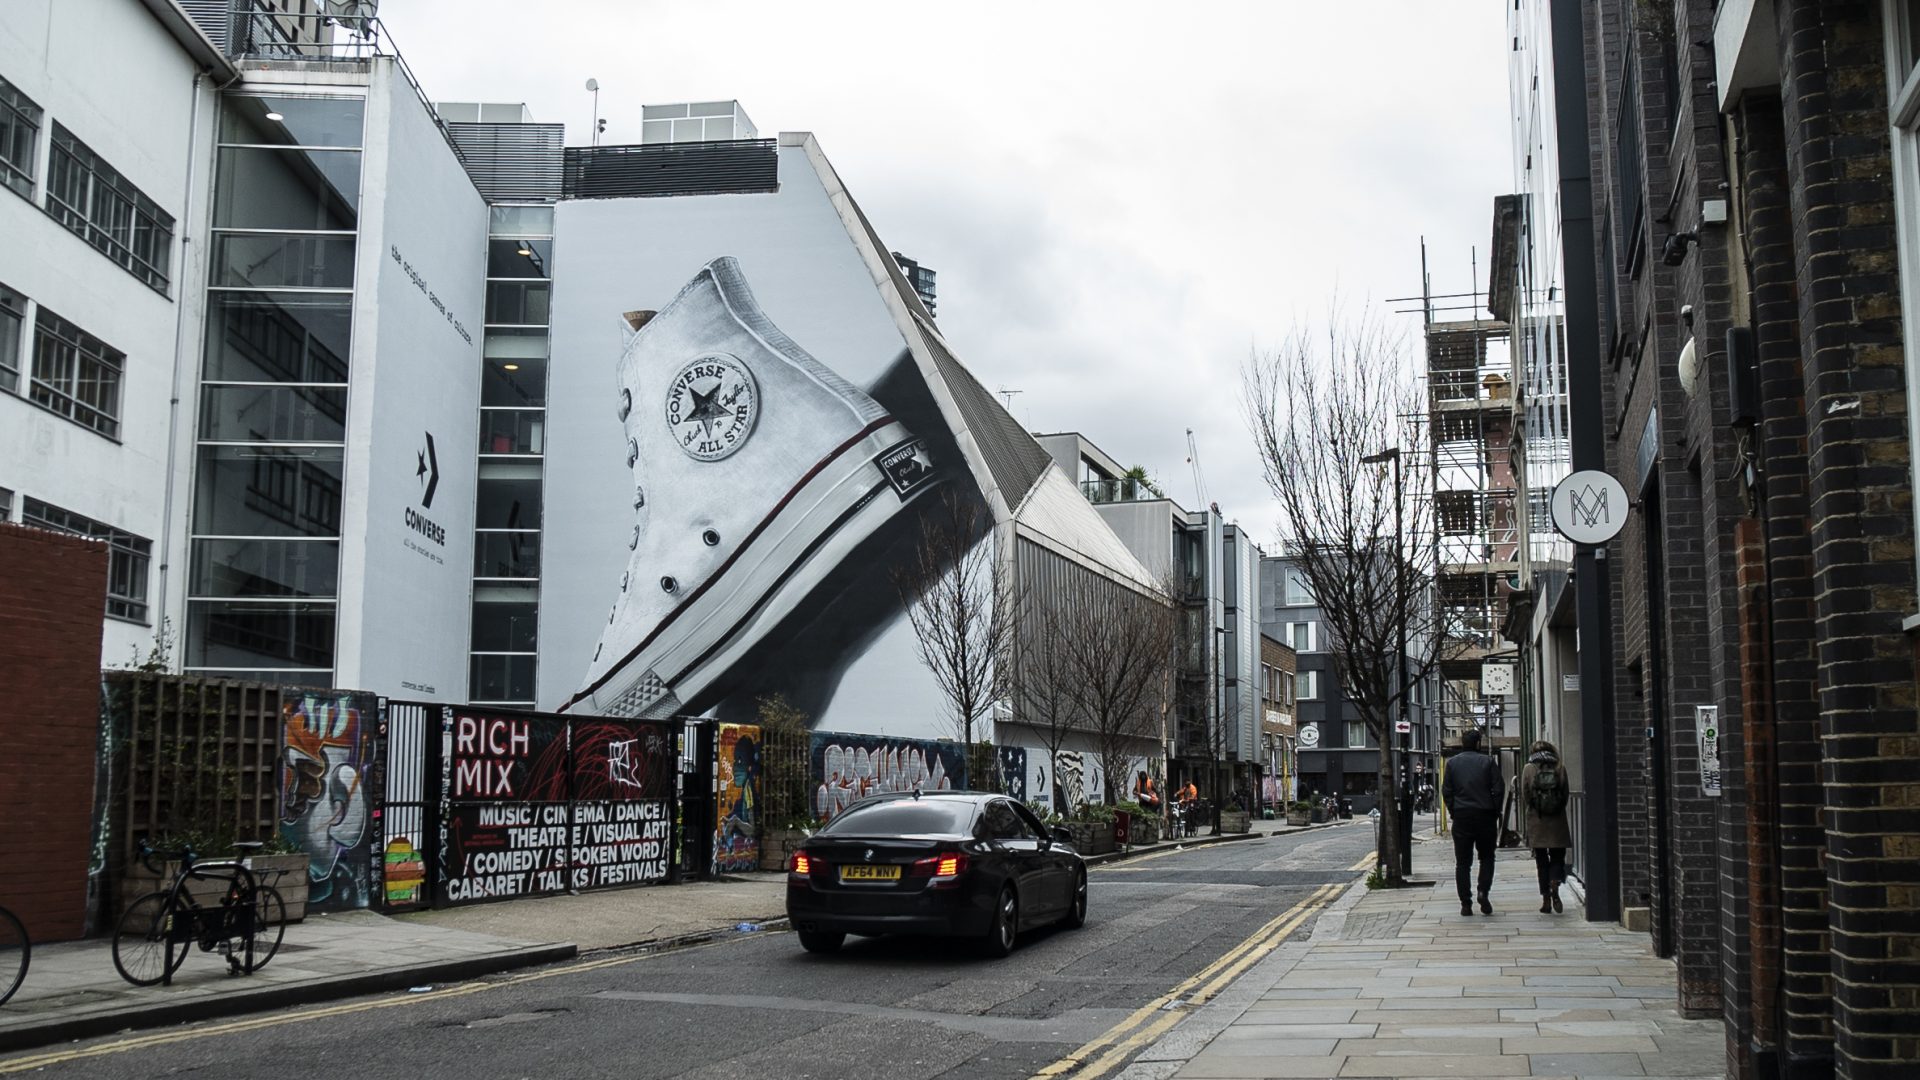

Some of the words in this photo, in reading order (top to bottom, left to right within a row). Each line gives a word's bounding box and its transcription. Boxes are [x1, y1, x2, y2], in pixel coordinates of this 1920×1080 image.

[670, 365, 726, 426] CONVERSE
[698, 440, 724, 453] ALL
[724, 404, 748, 444] STAR
[405, 506, 446, 547] CONVERSE
[457, 717, 529, 756] RICH
[456, 759, 514, 796] MIX
[480, 806, 531, 826] MUSIC
[543, 804, 605, 825] CINEMA
[616, 803, 660, 821] DANCE
[508, 826, 581, 849] THEATRE
[592, 822, 640, 844] VISUAL
[642, 820, 667, 840] ART
[473, 849, 543, 874] COMEDY
[555, 844, 618, 868] SPOKEN
[620, 841, 660, 862] WORD
[846, 866, 873, 877] AF64
[448, 873, 526, 900] CABARET
[538, 868, 589, 892] TALKS
[600, 859, 667, 885] FESTIVALS
